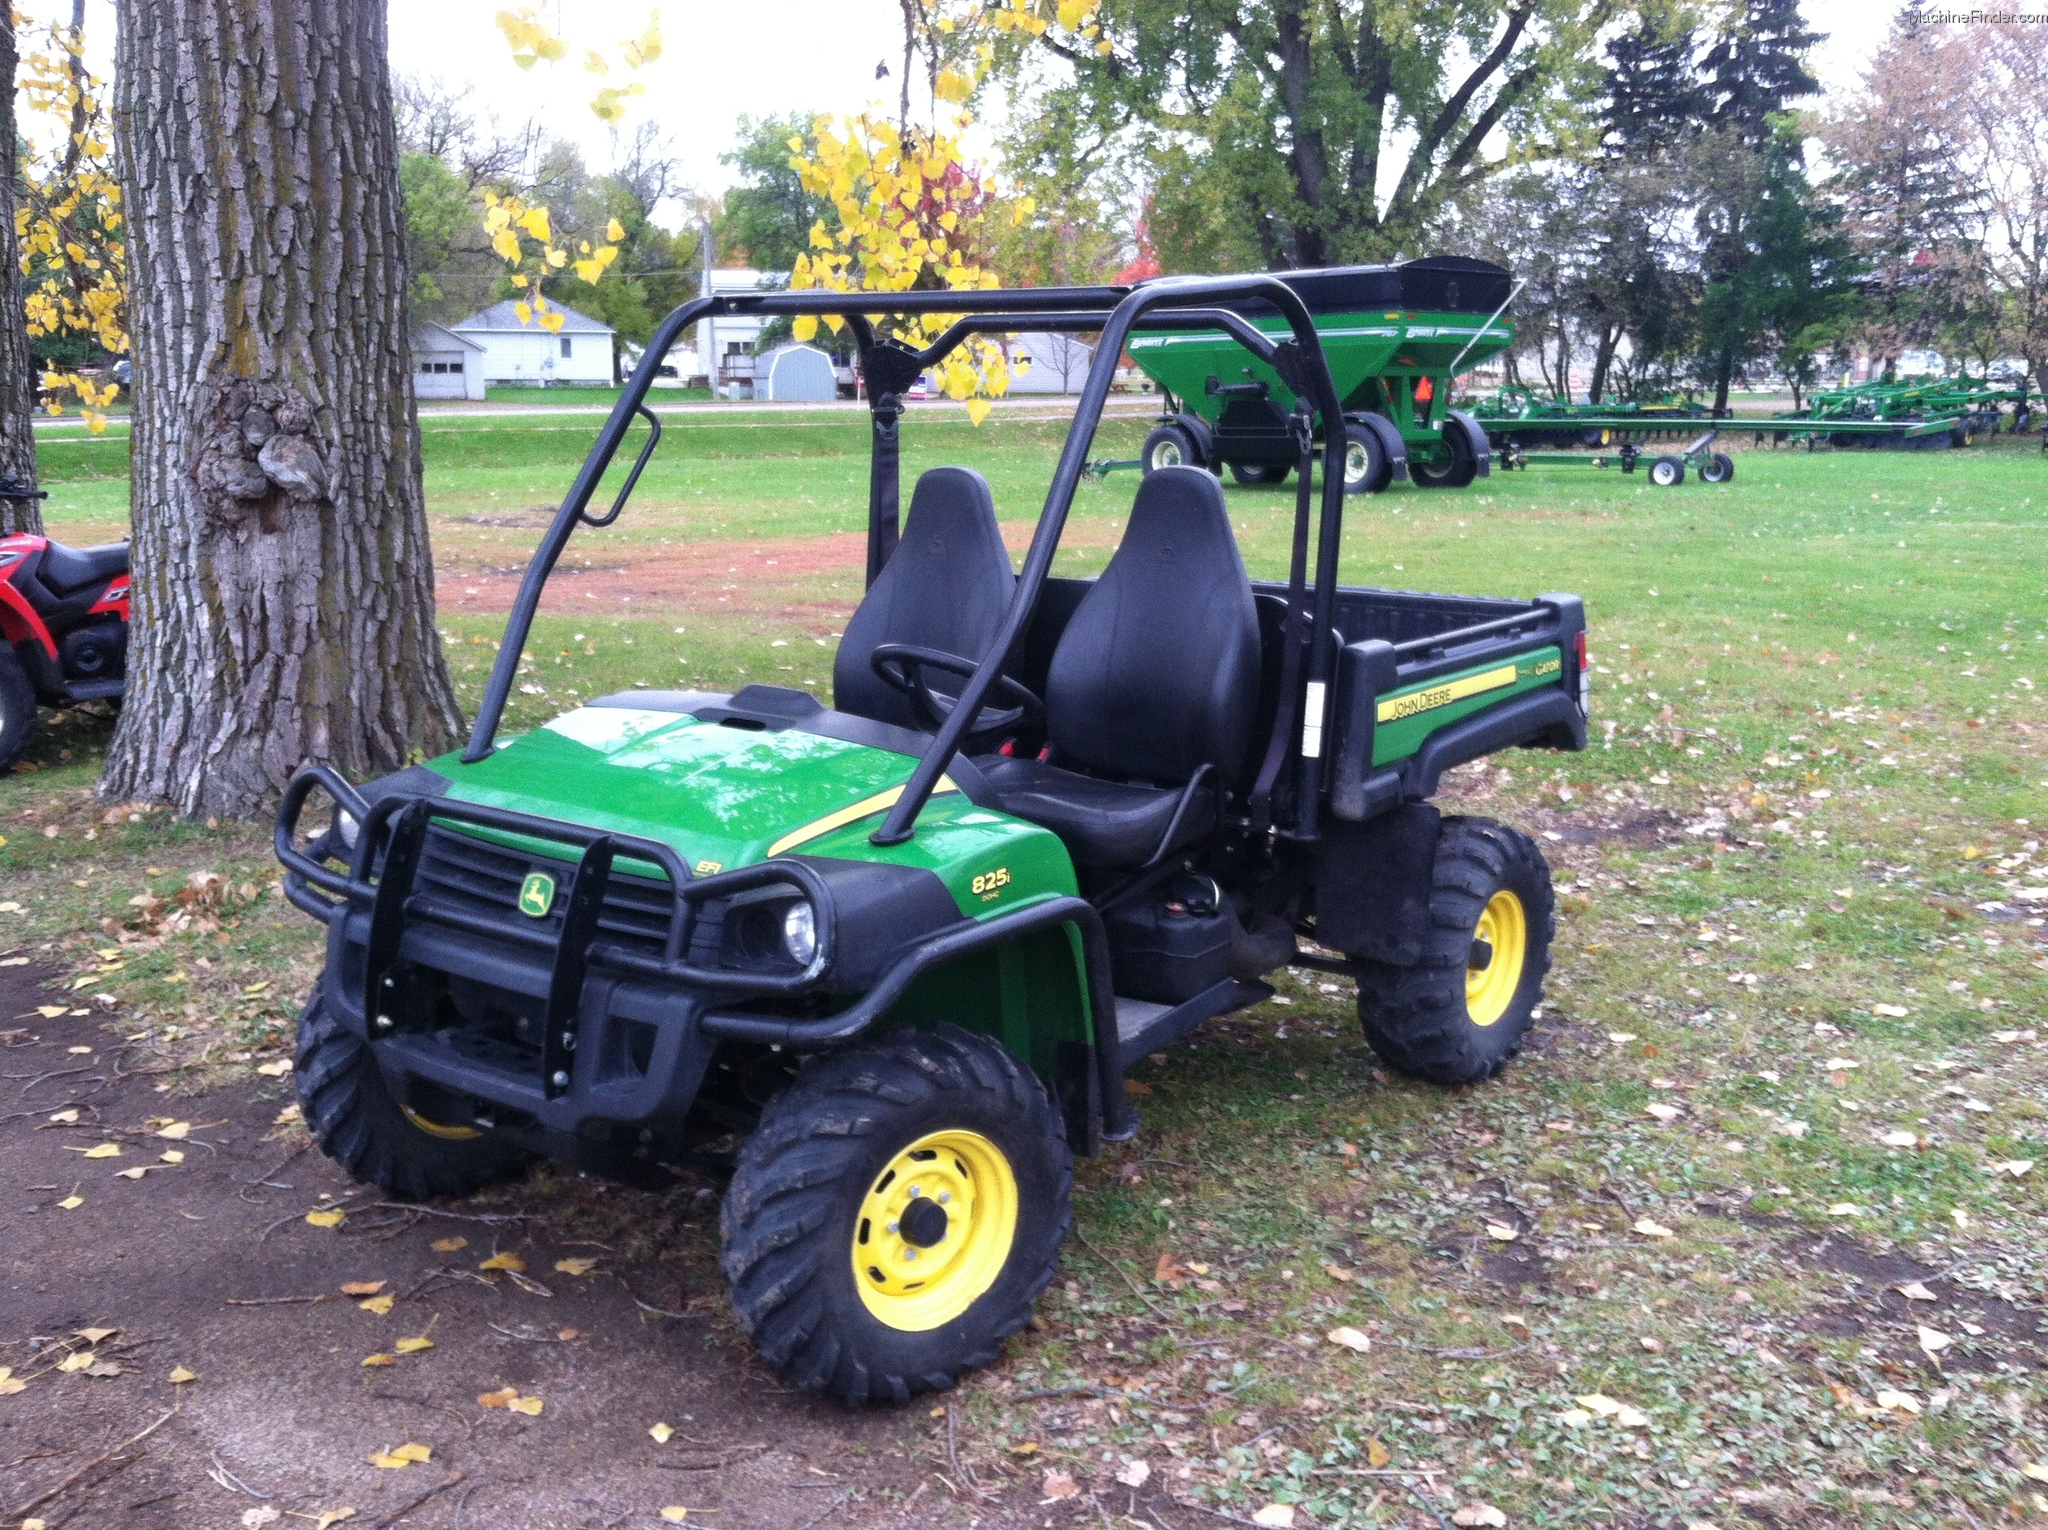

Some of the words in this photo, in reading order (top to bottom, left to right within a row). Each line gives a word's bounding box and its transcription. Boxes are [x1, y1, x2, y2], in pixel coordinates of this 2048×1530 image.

[1390, 698, 1418, 719] JOHN
[1419, 688, 1451, 709] DEERE
[971, 866, 1011, 894] 825i
